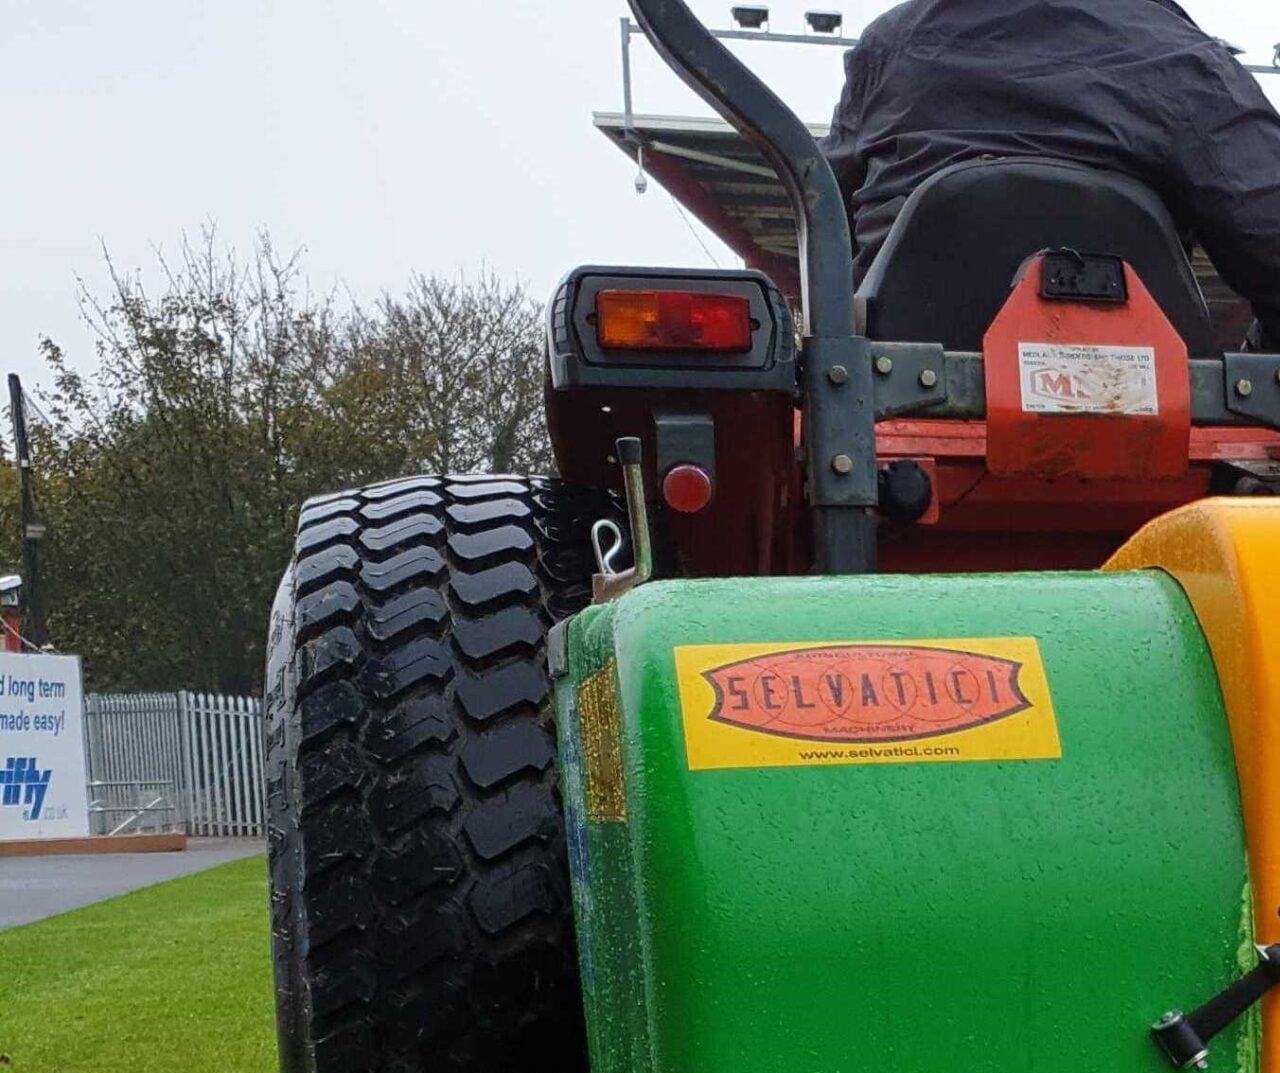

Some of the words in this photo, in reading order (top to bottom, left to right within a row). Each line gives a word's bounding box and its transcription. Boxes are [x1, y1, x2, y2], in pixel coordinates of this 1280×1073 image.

[8, 676, 35, 702] long
[38, 679, 65, 698] term
[728, 669, 1000, 711] SELVATICI
[33, 711, 65, 736] easy!
[799, 746, 960, 760] www.selvatici.com
